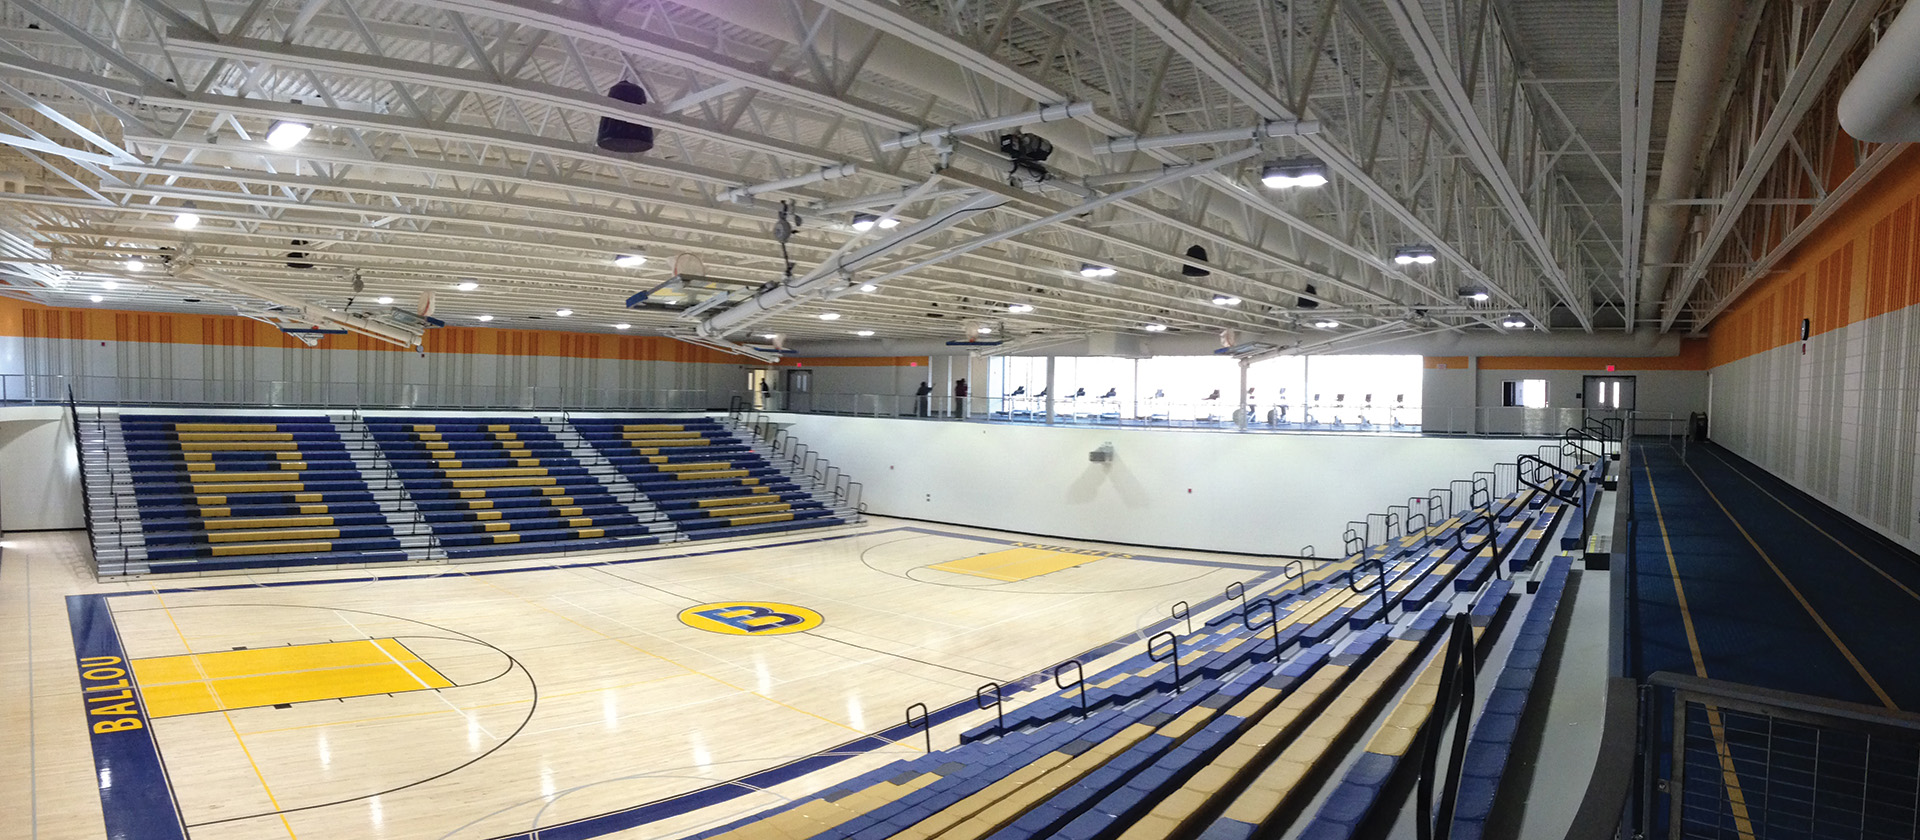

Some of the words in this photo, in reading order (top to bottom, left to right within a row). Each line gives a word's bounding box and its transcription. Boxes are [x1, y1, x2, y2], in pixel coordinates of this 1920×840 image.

[1011, 542, 1133, 559] KNIGHTS
[692, 606, 805, 633] B
[80, 656, 143, 734] BALLOU
